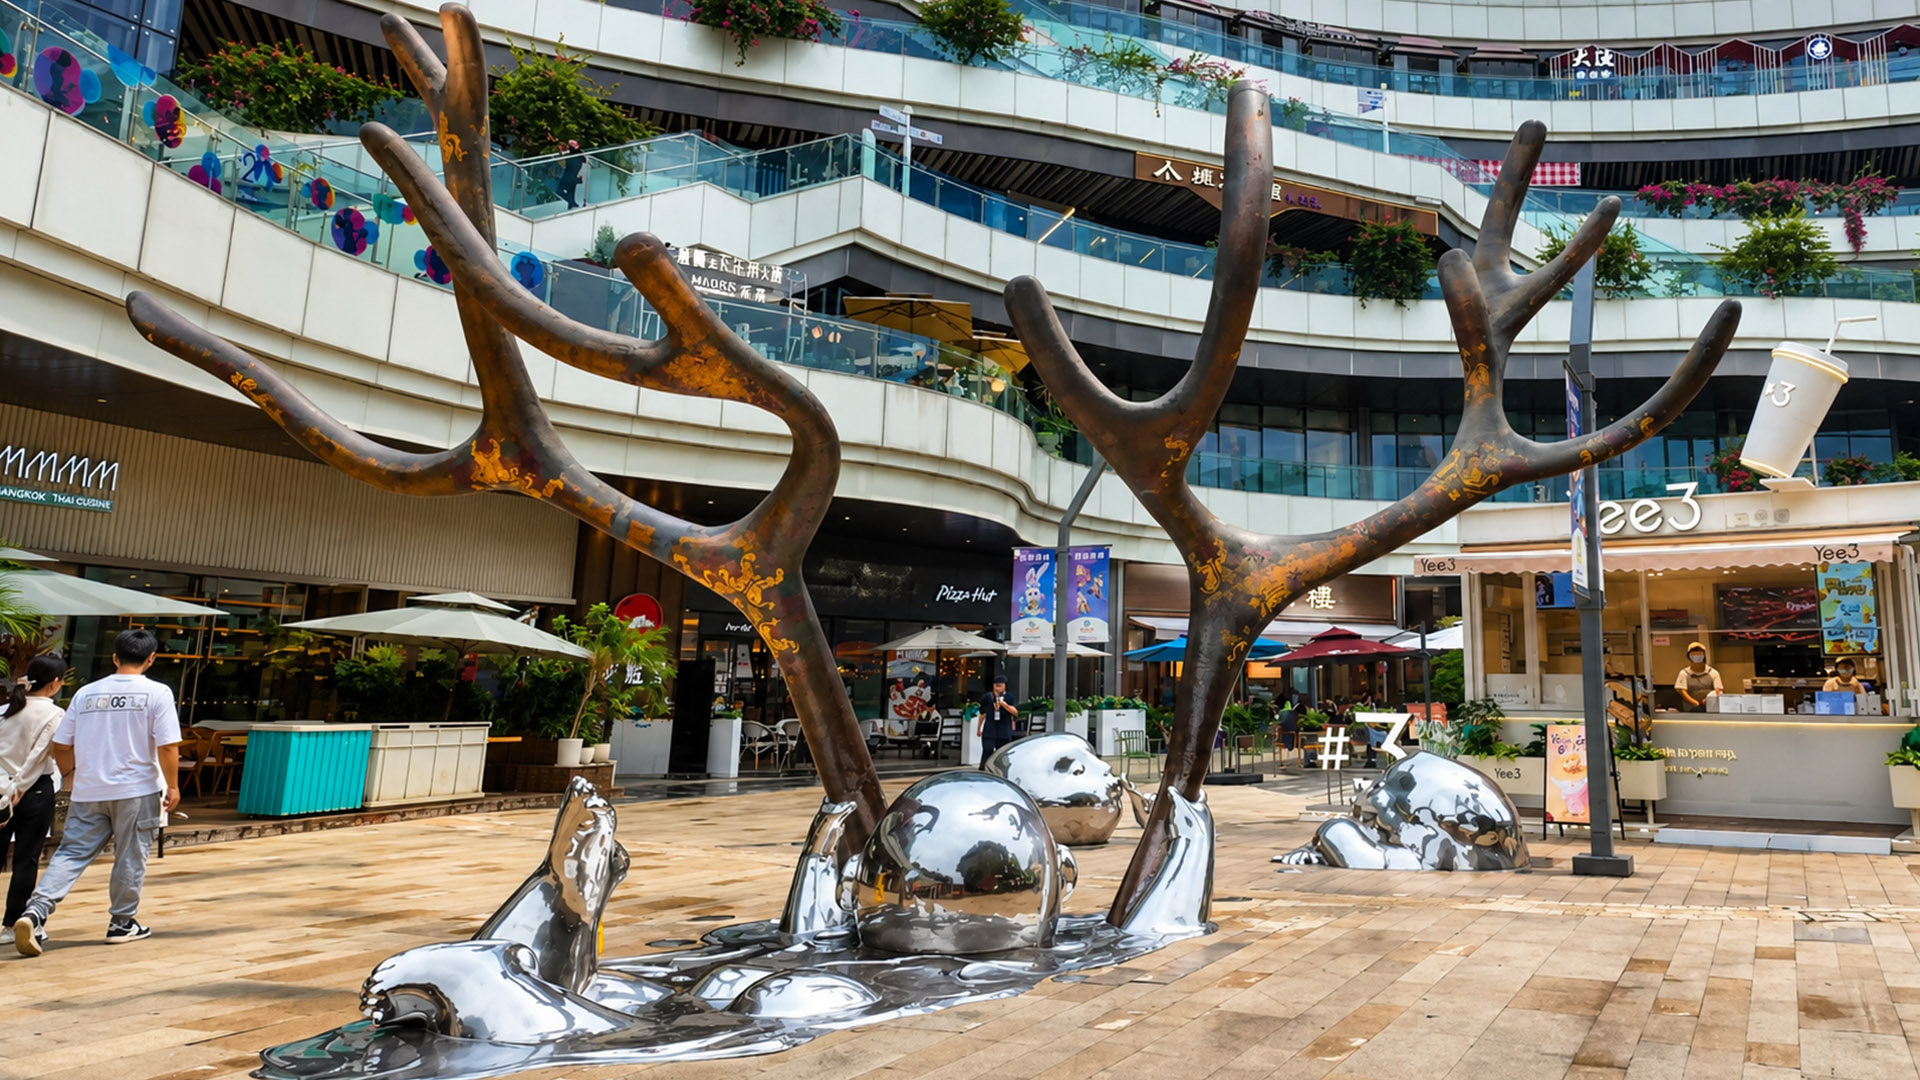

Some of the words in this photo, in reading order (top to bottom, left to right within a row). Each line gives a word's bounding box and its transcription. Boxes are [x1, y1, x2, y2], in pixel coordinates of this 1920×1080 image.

[0, 487, 46, 501] ANGKOK
[52, 493, 74, 505] THAI
[1566, 482, 1702, 535] ee3
[1813, 543, 1860, 561] Yee3
[1421, 558, 1456, 572] Yee3
[936, 584, 970, 603] Pizza
[972, 587, 998, 602] Hut
[1494, 768, 1521, 779] Yee3
